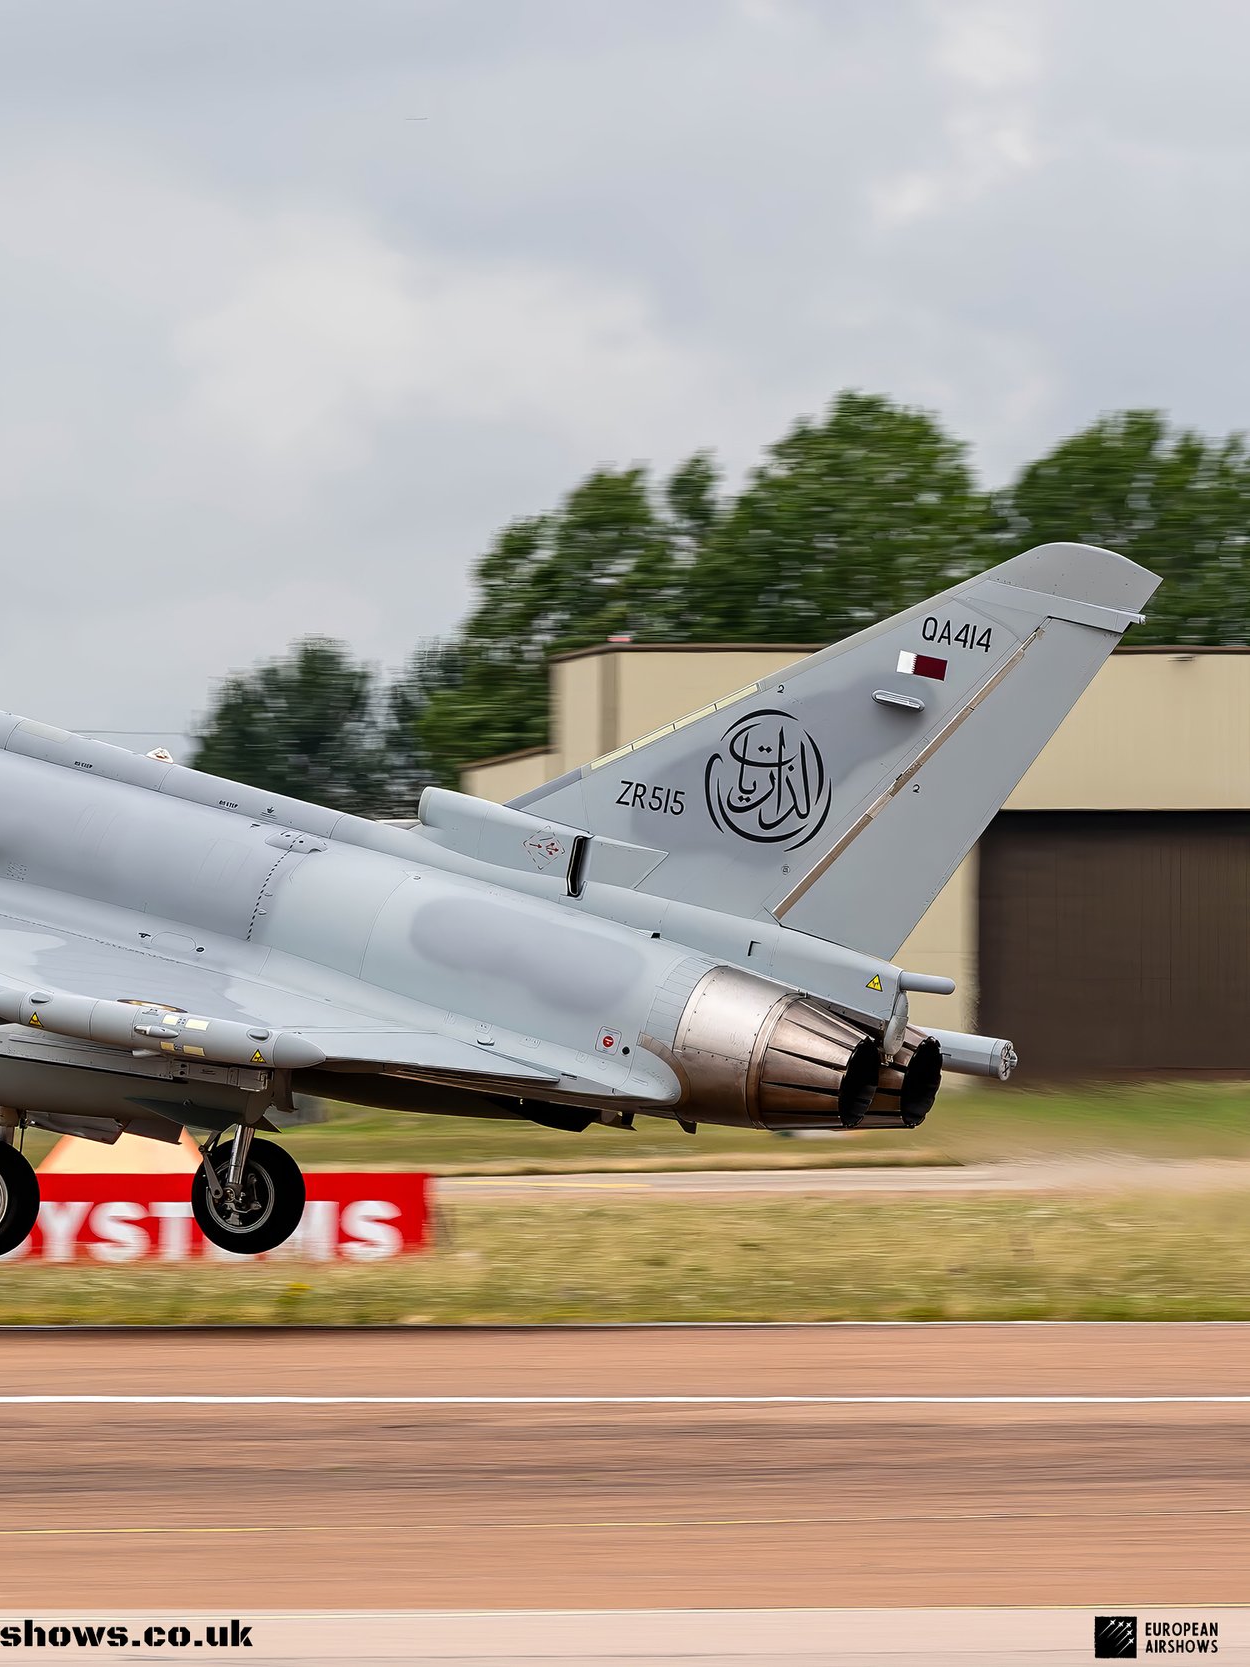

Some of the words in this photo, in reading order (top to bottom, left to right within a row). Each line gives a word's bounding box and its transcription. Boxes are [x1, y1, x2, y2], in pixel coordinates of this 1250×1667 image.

[922, 617, 992, 652] QA414
[777, 684, 785, 693] 2
[616, 781, 686, 816] ZR515
[913, 784, 921, 793] 2
